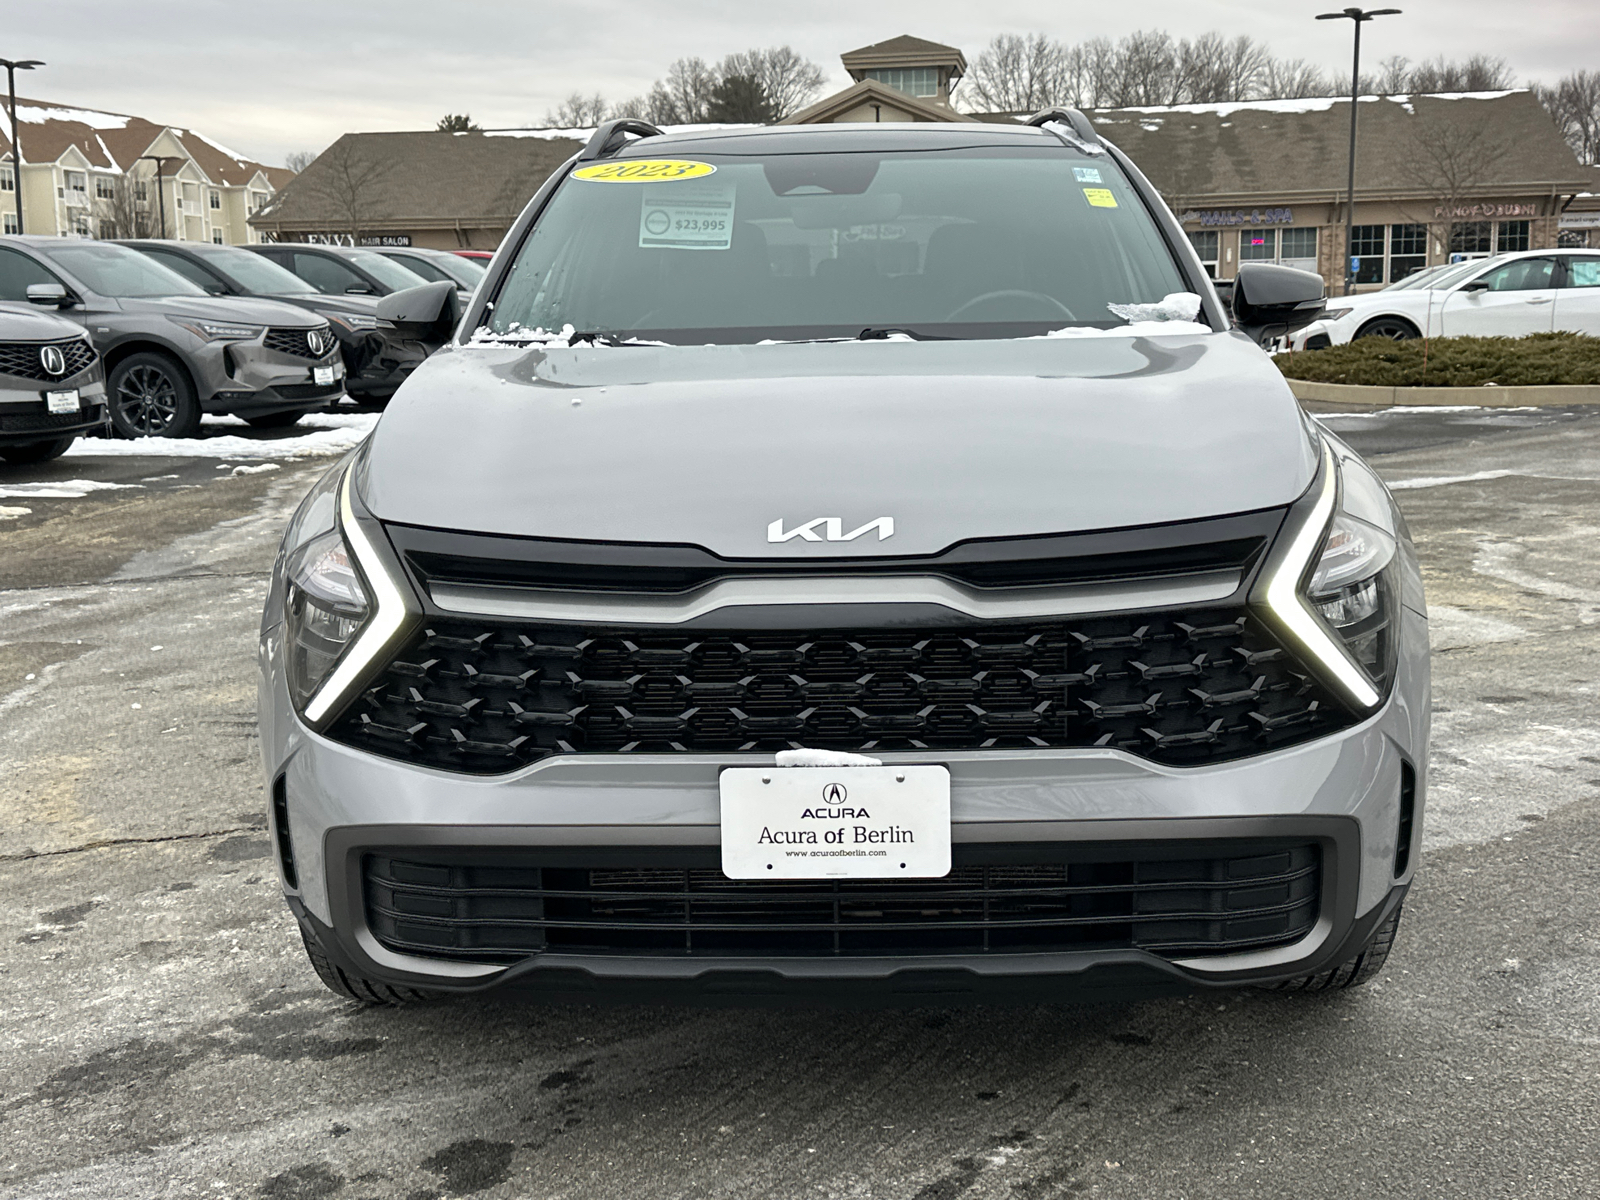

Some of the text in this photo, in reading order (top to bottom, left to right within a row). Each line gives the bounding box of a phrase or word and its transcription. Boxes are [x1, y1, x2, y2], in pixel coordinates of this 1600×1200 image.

[590, 164, 696, 178] 2023
[1200, 209, 1244, 226] NAILS
[1250, 208, 1261, 224] &
[1264, 207, 1293, 224] SPA
[675, 219, 725, 232] $23,995
[308, 233, 355, 248] ENVY
[361, 237, 409, 246] HAIR SALON
[801, 808, 870, 819] ACURA
[758, 825, 915, 844] Acura of Berlin
[785, 849, 887, 857] www.acuraofberlin.com
